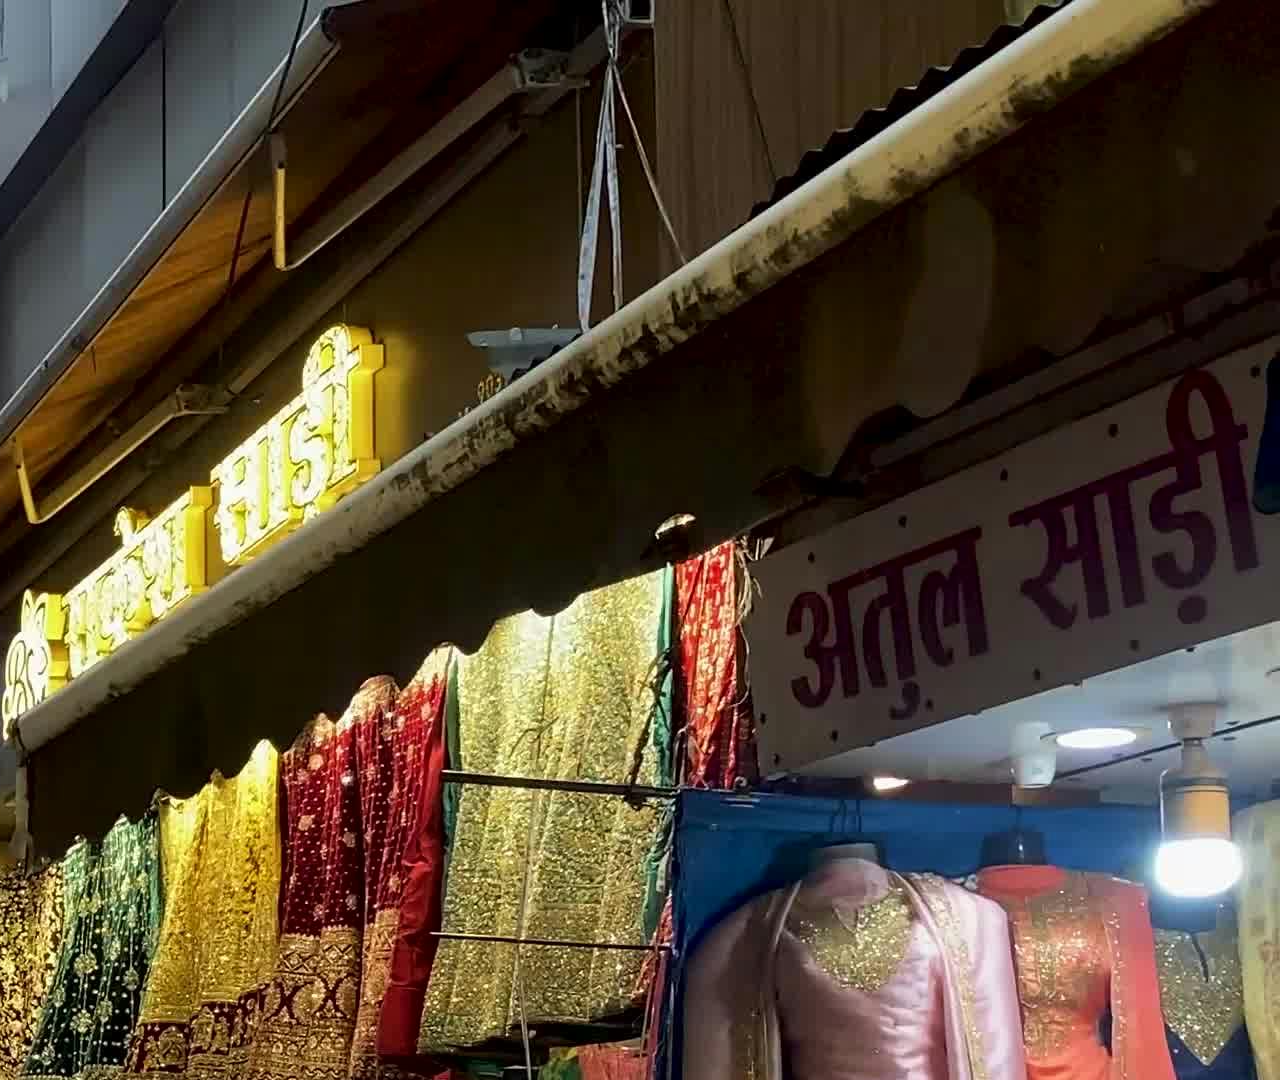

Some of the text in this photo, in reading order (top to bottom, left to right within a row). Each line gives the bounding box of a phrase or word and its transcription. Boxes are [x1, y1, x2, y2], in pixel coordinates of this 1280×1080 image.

[210, 323, 370, 566] साड़ी
[786, 368, 1259, 720] अतुल साड़ी
